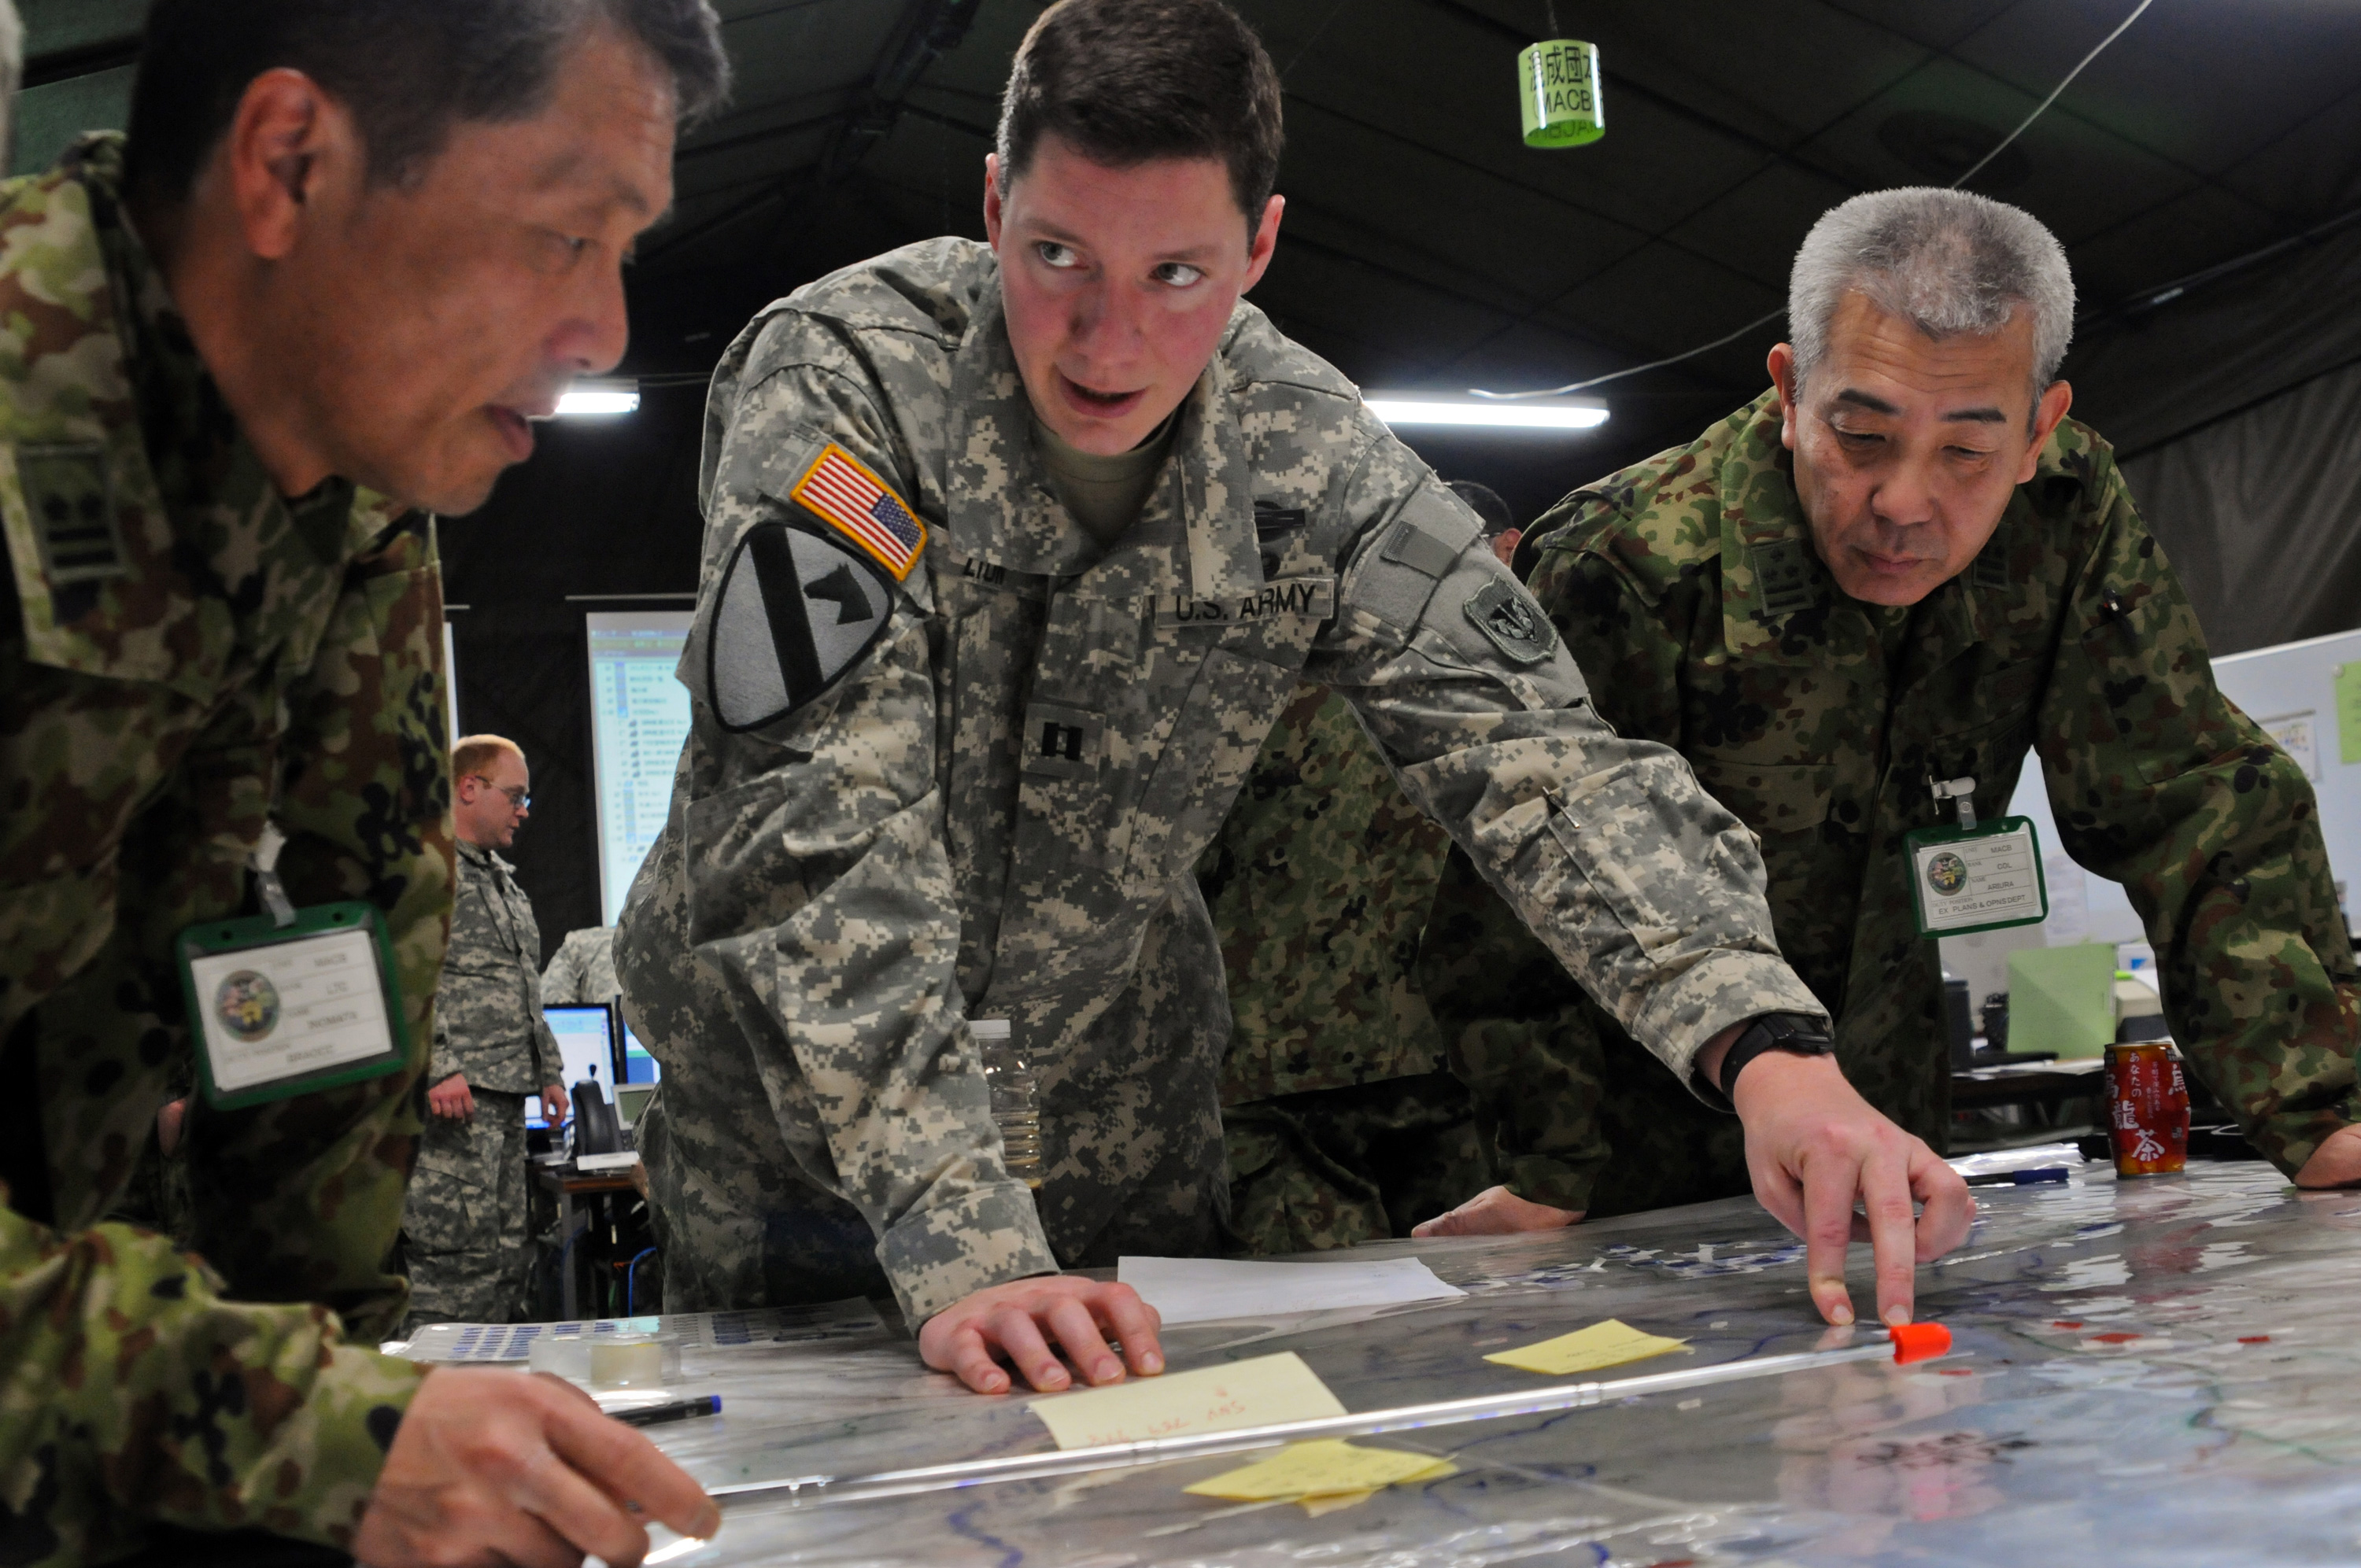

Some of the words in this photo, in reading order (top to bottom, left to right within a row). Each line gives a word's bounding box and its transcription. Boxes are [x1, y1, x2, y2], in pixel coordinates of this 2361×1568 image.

[1177, 596, 1228, 621] U.S.
[1240, 584, 1315, 619] ARMY
[1990, 844, 2012, 853] MACB
[1953, 902, 1978, 912] PLANS
[2008, 895, 2026, 903] DEPT
[2129, 1052, 2142, 1098] あなたの
